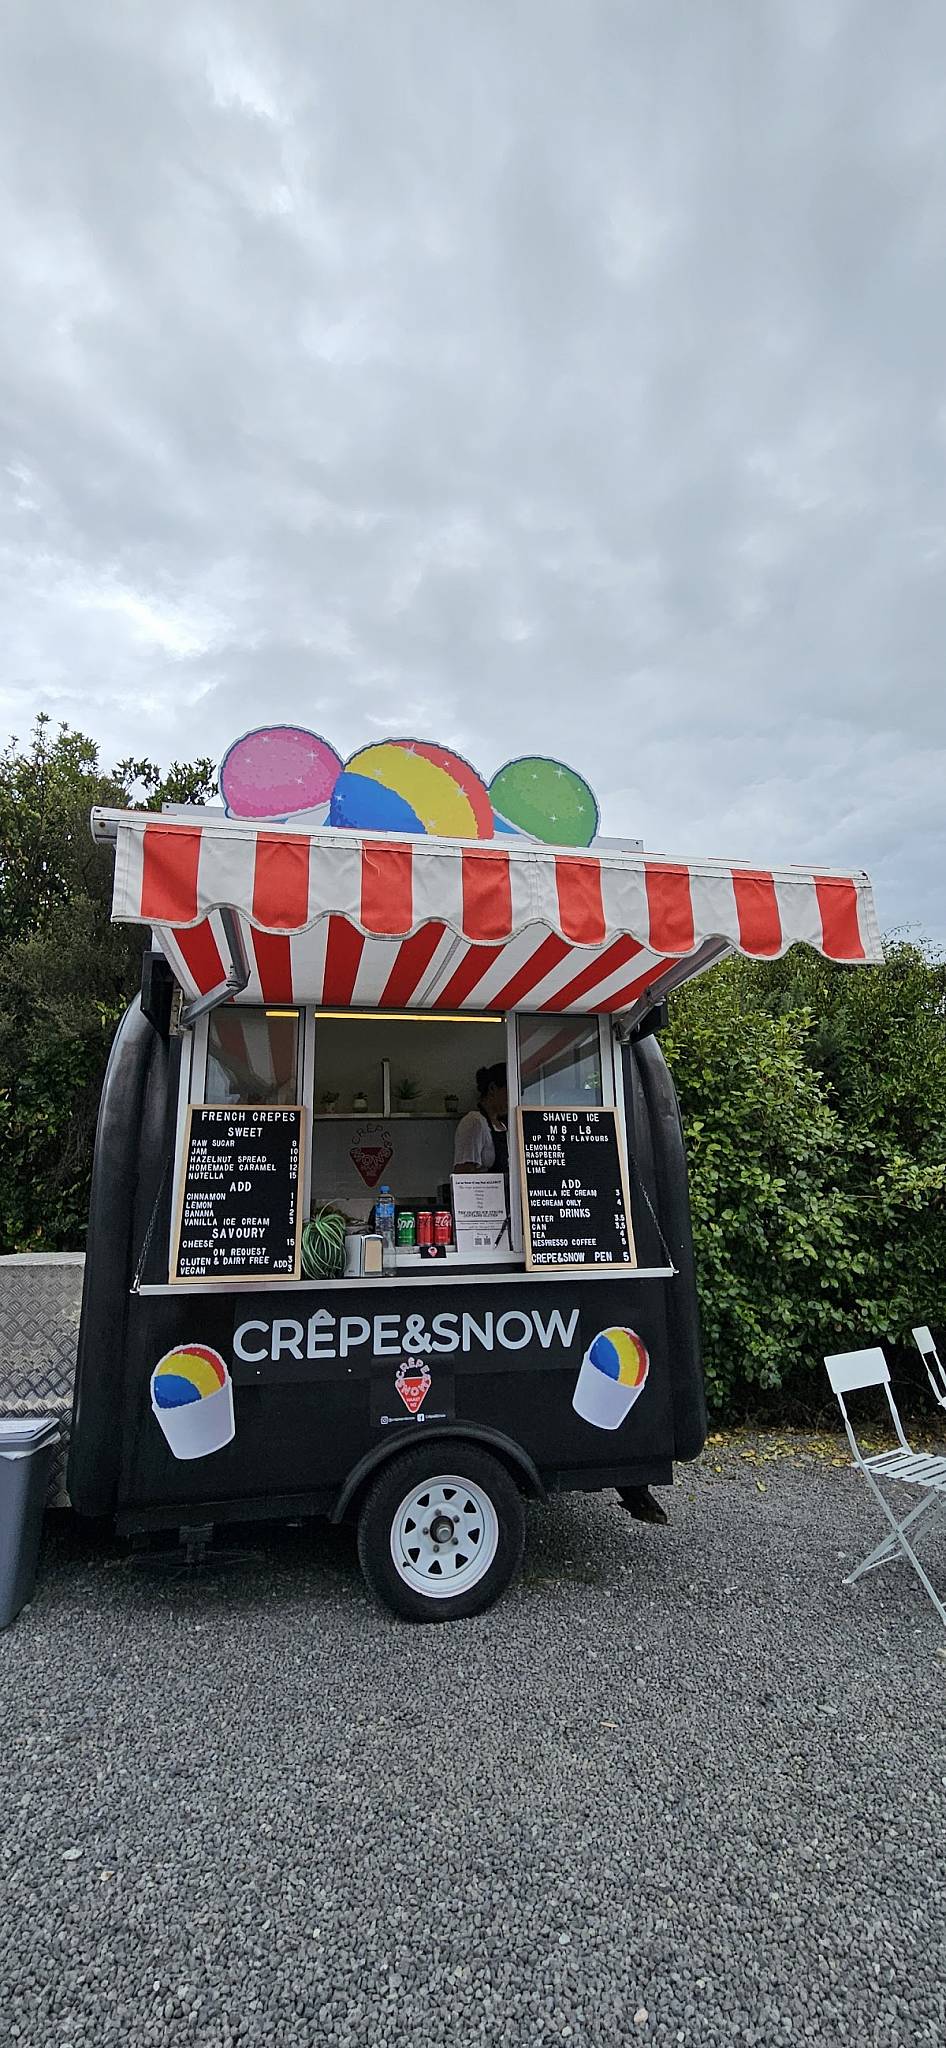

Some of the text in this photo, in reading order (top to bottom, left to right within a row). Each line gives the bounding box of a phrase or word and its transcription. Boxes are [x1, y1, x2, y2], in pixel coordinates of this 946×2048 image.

[202, 1112, 296, 1122] FRENCH CREPES
[543, 1113, 599, 1122] SHAVED ICE
[228, 1127, 263, 1137] SWEET
[229, 1182, 252, 1192] ADD
[561, 1180, 581, 1189] ADD
[186, 1201, 212, 1209] LEMON
[560, 1209, 591, 1218] DRINKS
[184, 1217, 294, 1226] VANILLA ICE CREAM 3
[212, 1228, 266, 1238] SAVOURY
[182, 1240, 214, 1248] CHEESE
[213, 1257, 219, 1265] &
[223, 1257, 246, 1265] DAIRY
[249, 1256, 270, 1264] FREE
[532, 1252, 629, 1263] CREPE&SNOW PEN 5
[273, 1260, 287, 1268] ADD
[180, 1267, 206, 1275] VEGAN
[233, 1308, 580, 1362] CRÊPE&SNOW
